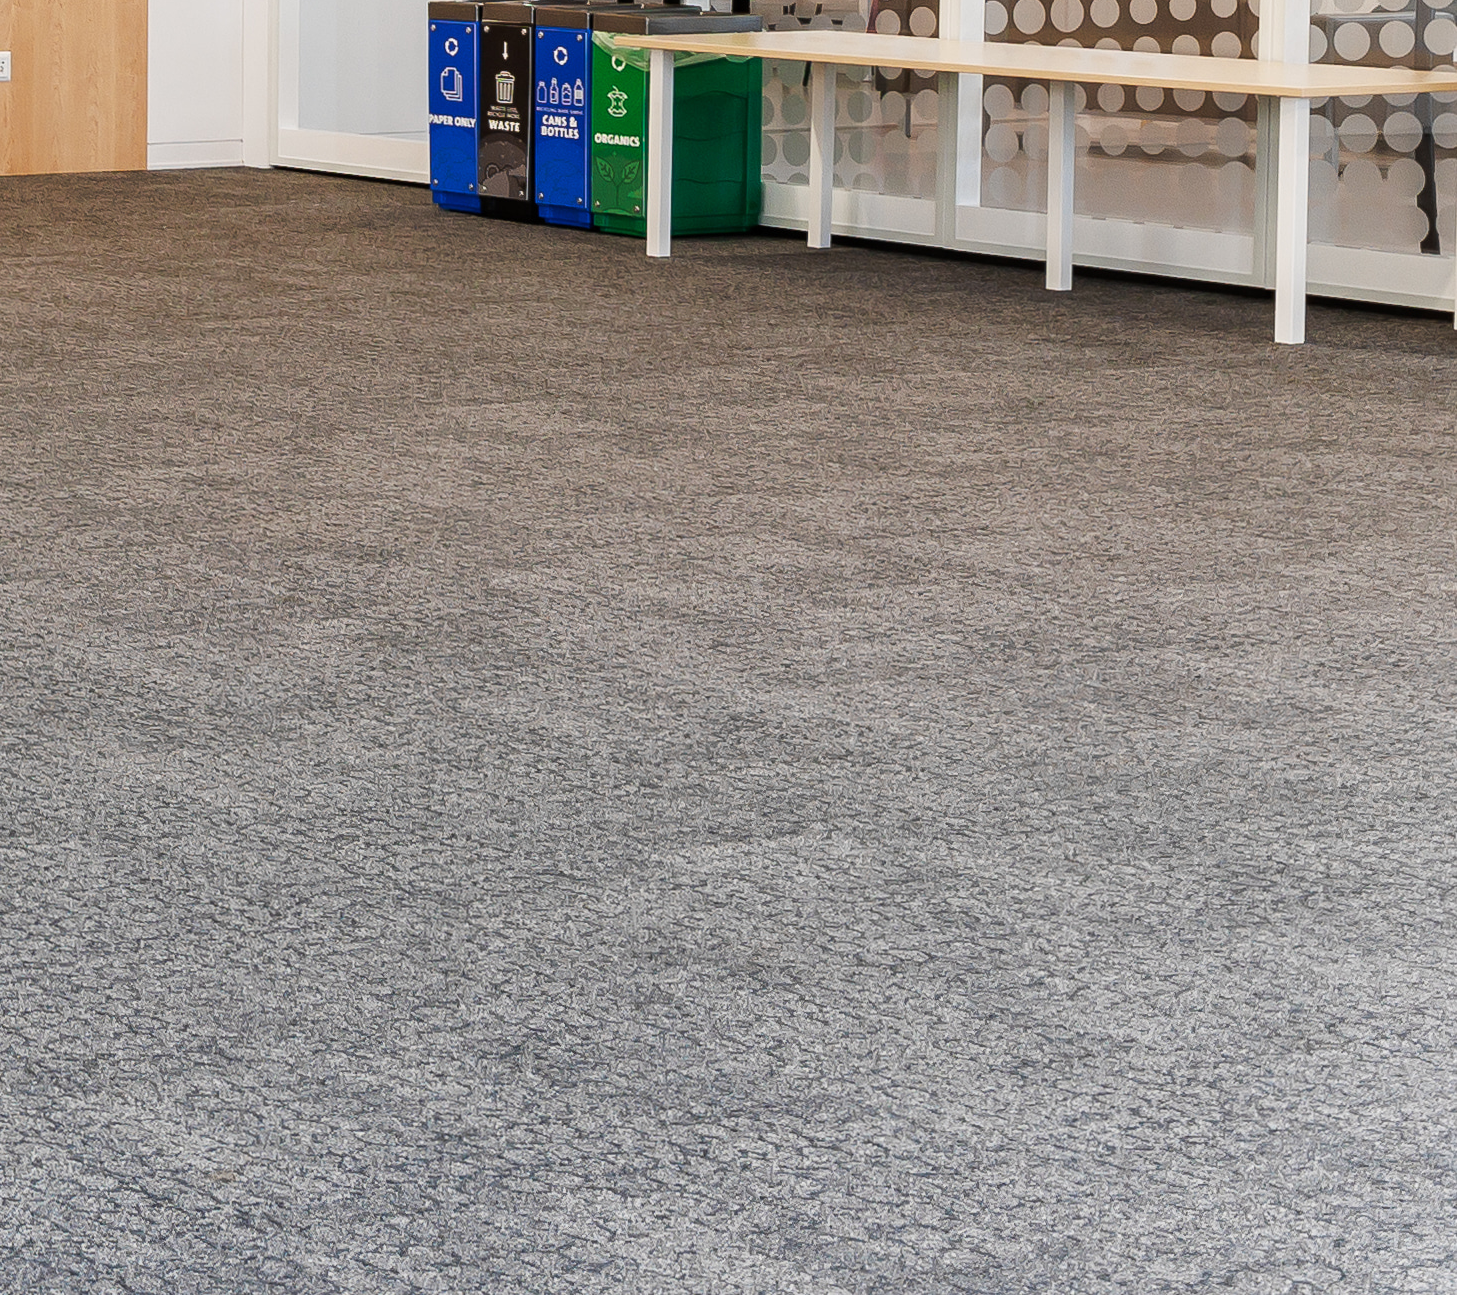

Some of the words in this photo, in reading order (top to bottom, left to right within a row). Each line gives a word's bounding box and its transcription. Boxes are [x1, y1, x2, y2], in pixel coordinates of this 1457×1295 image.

[429, 114, 453, 126] PAPER
[454, 116, 476, 128] ONLY
[489, 120, 520, 132] WASTE
[542, 115, 567, 127] CANS
[569, 117, 578, 127] &
[541, 126, 579, 139] BOTTLES
[594, 133, 640, 147] ORGANICS
